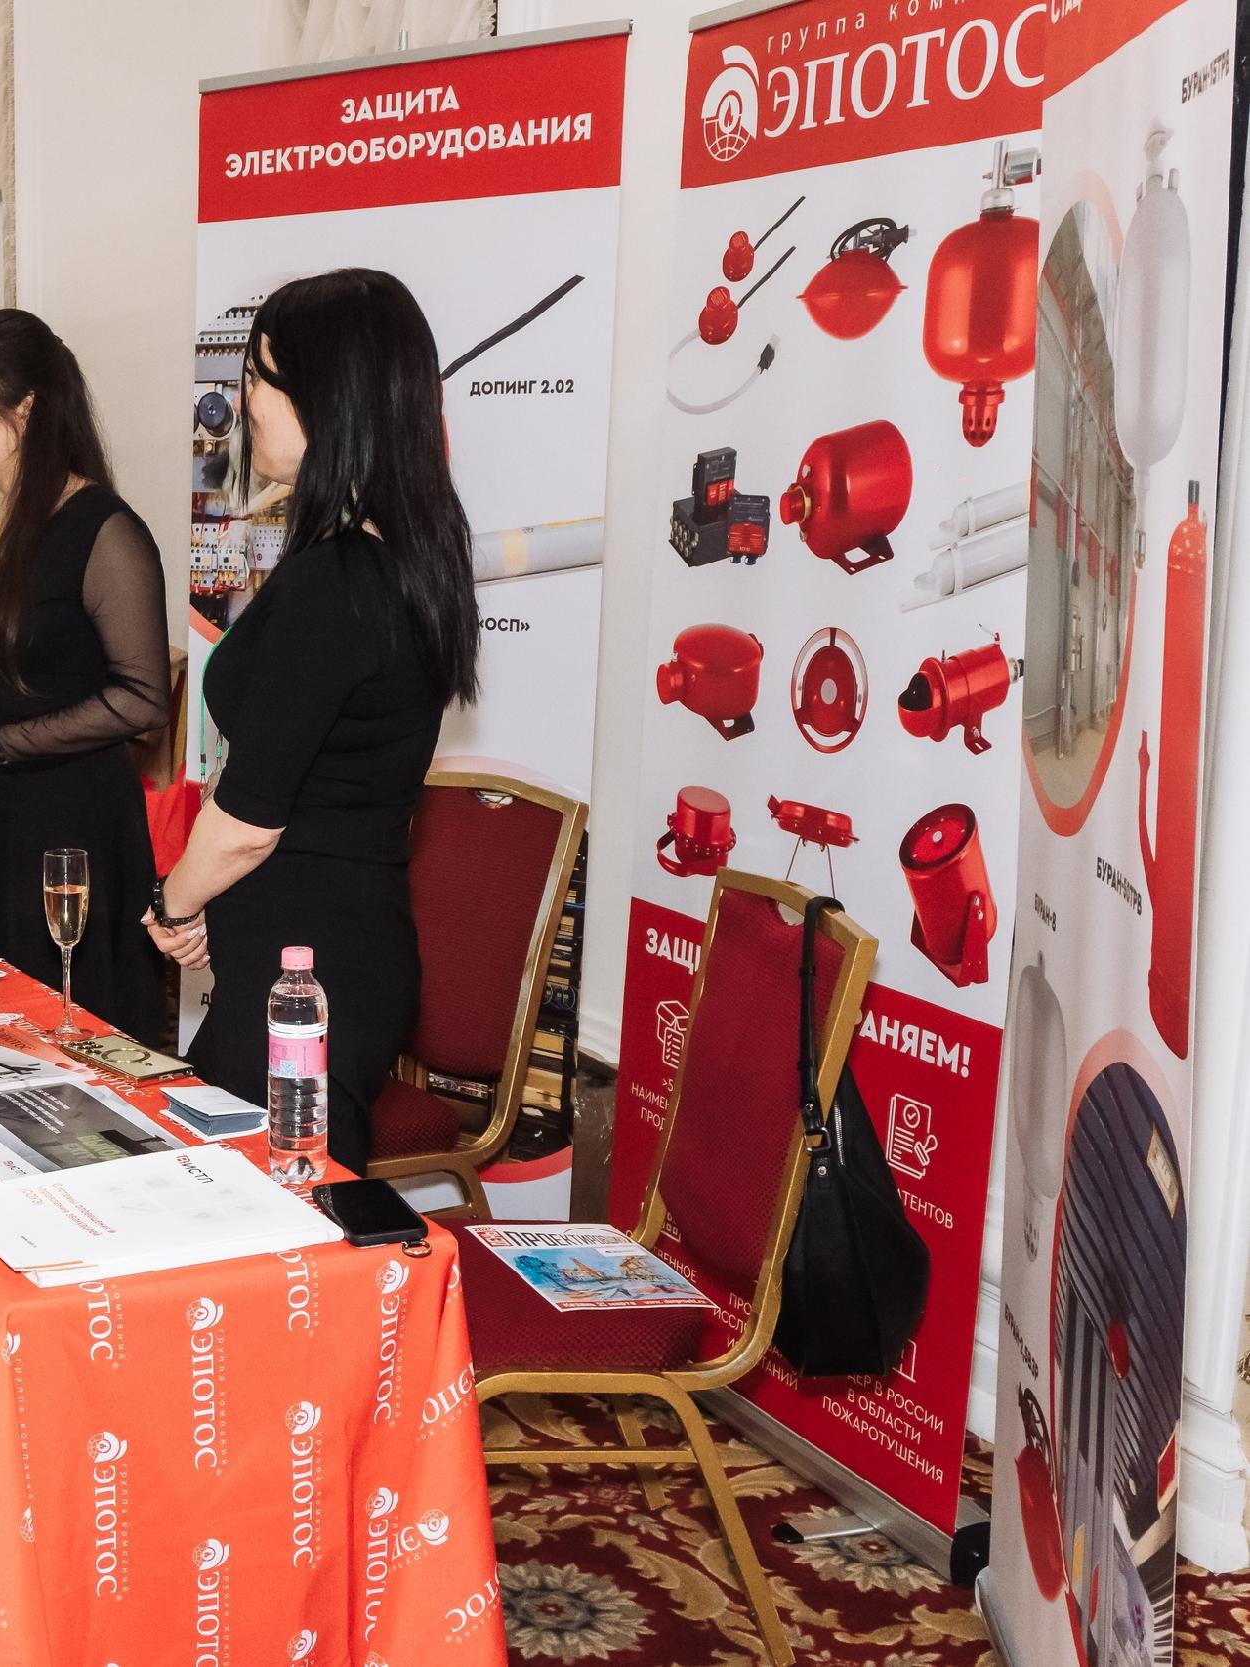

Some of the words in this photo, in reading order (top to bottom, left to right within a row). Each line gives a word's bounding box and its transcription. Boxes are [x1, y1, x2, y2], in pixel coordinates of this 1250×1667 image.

[764, 3, 1047, 138] ЭПОТОС
[766, 12, 865, 54] группа
[340, 84, 460, 125] ЗАЩИТА
[225, 112, 592, 179] ЭЛЕКТРООБОРУДОВАНИЯ
[469, 380, 537, 397] ДОПИНГ
[540, 378, 575, 395] 2.02
[373, 1295, 400, 1426] ЭПОТОС
[191, 1330, 219, 1472] ЭПОТОС
[822, 1395, 944, 1485] ПОЖАРОТУШЕНИЯ
[847, 1388, 855, 1403] В
[858, 1395, 921, 1445] ОБЛАСТИ
[875, 1381, 883, 1397] В
[887, 1388, 944, 1435] РОССИИ
[93, 1465, 119, 1599] ЭПОТОС
[291, 1434, 314, 1568] ЭПОТОС
